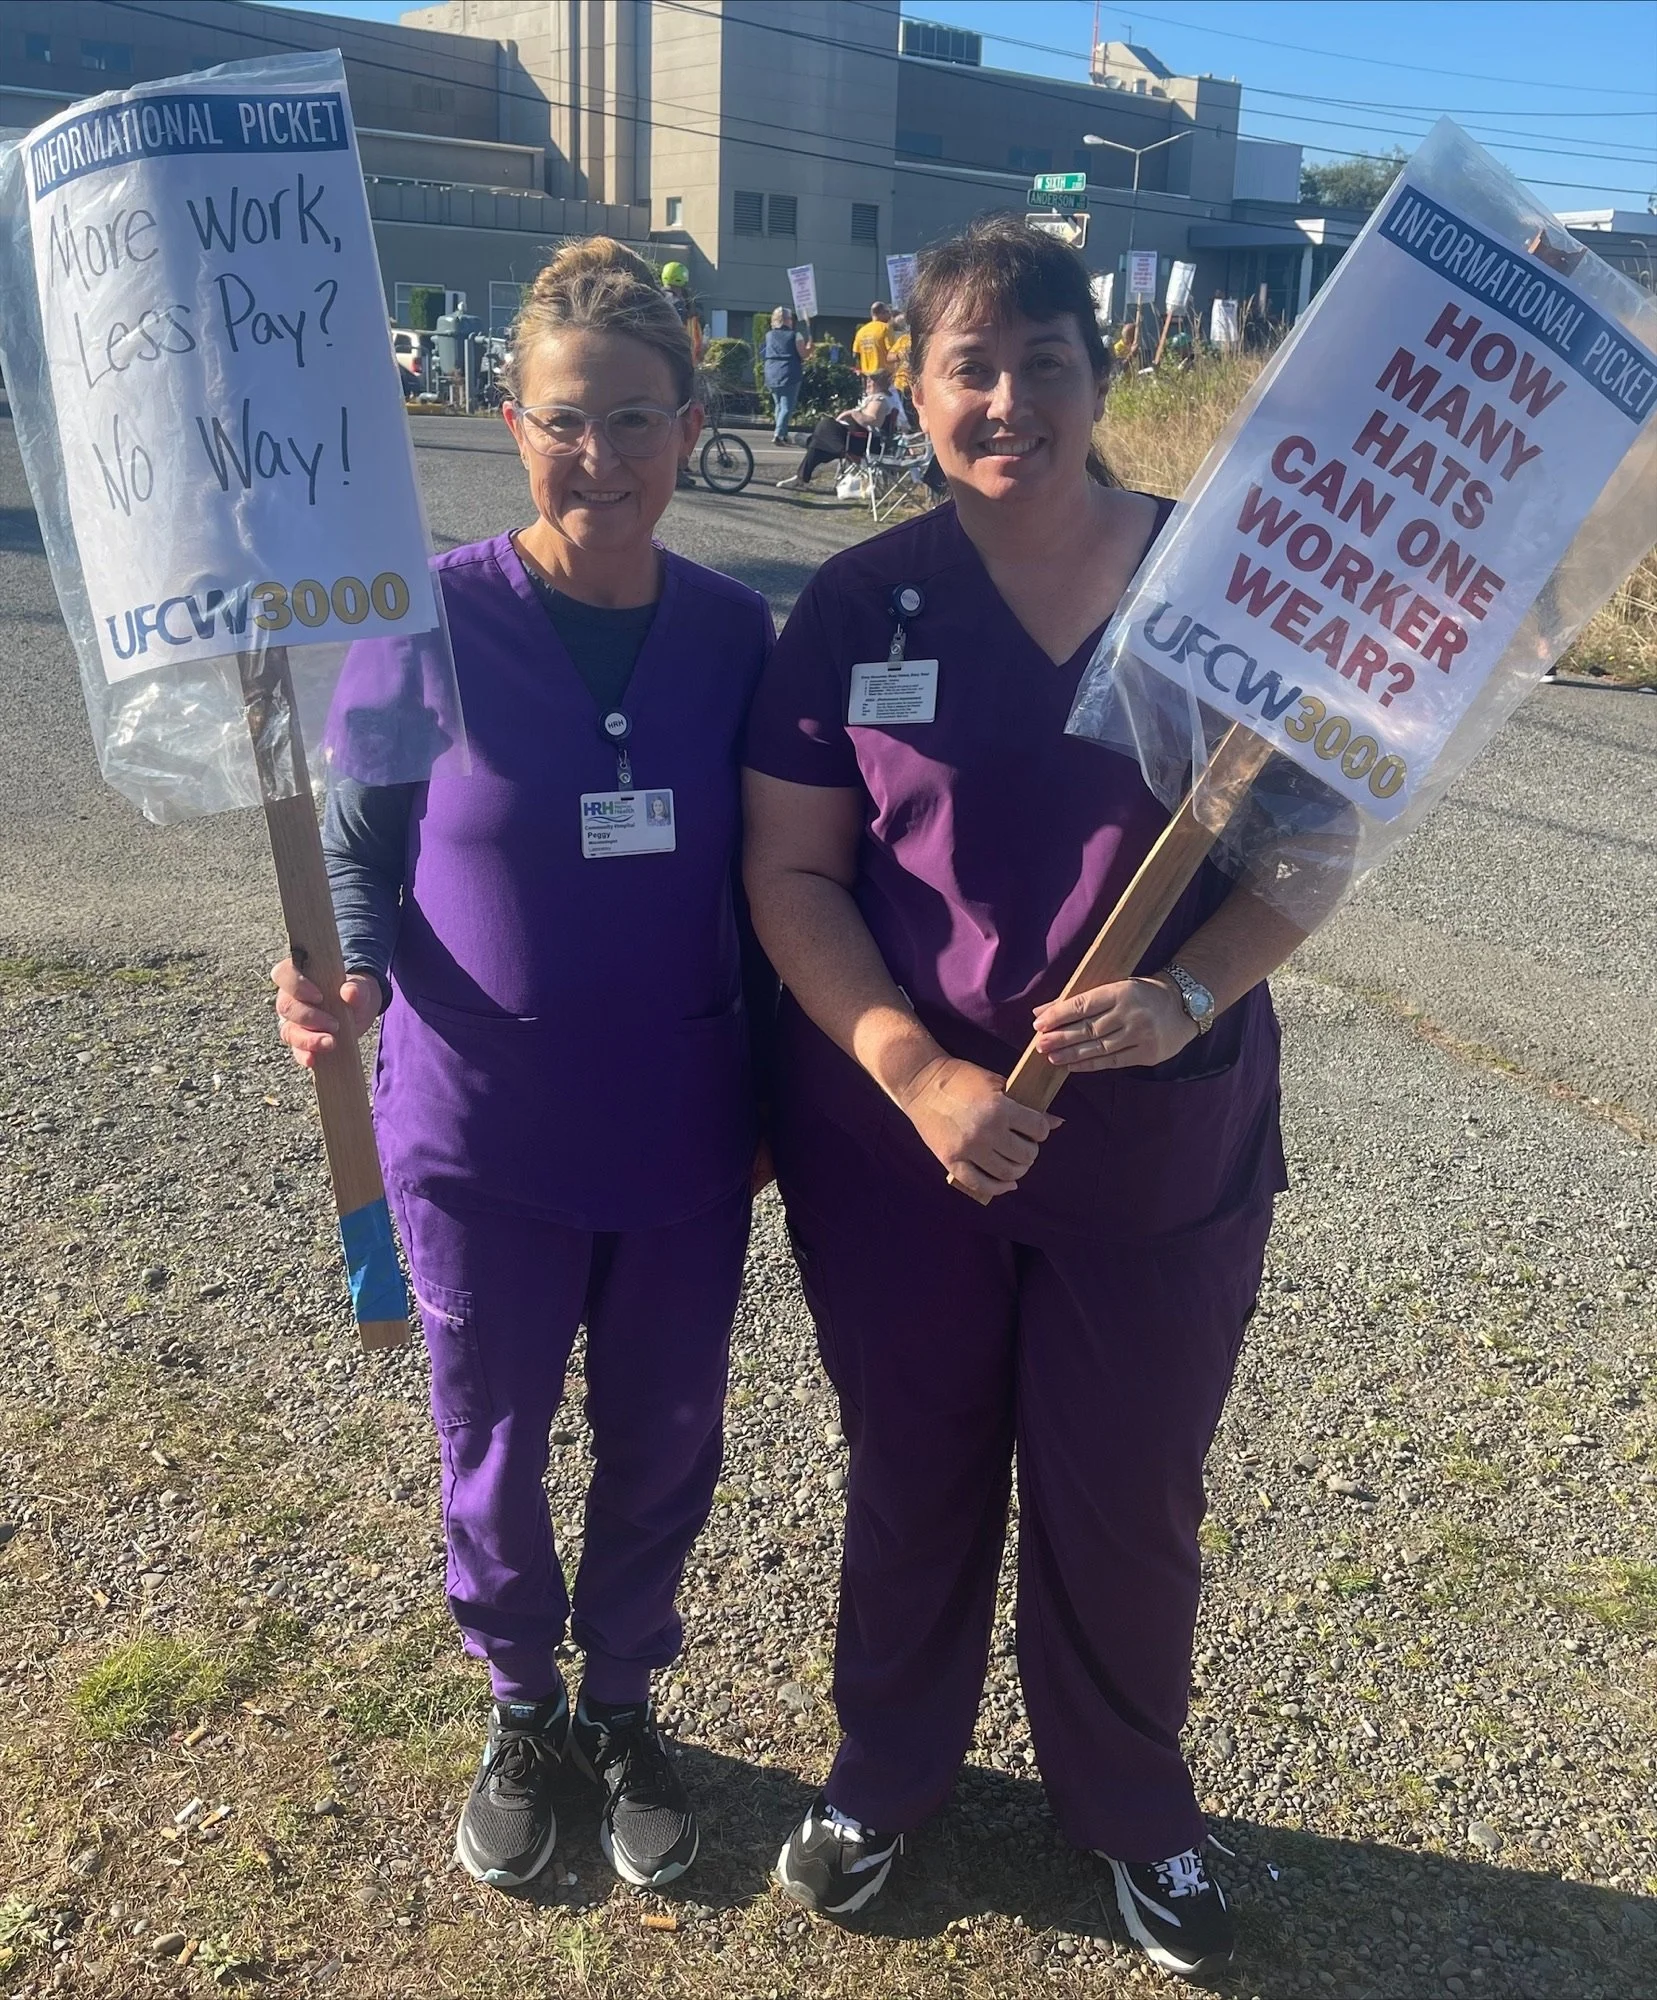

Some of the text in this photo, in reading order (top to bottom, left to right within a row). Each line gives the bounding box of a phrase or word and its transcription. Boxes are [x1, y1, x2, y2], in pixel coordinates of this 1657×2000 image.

[34, 100, 340, 191] INFORMATIONAL PICKET
[1030, 191, 1075, 207] ANDERSON
[1045, 175, 1066, 189] SIXTH
[49, 173, 342, 292] More Work,
[73, 273, 339, 389] Less Pay?
[1389, 196, 1657, 413] INFORMATIONAL PICKET
[1424, 301, 1568, 419] HOW
[93, 398, 350, 516] No Way!
[1351, 408, 1493, 530] HATS
[1375, 346, 1544, 482] MANY
[1236, 482, 1468, 674] WORKER
[1271, 435, 1506, 621] CAN ONE
[1225, 552, 1415, 708] WEAR?
[583, 801, 614, 816] HRH
[587, 831, 611, 839] Peggy
